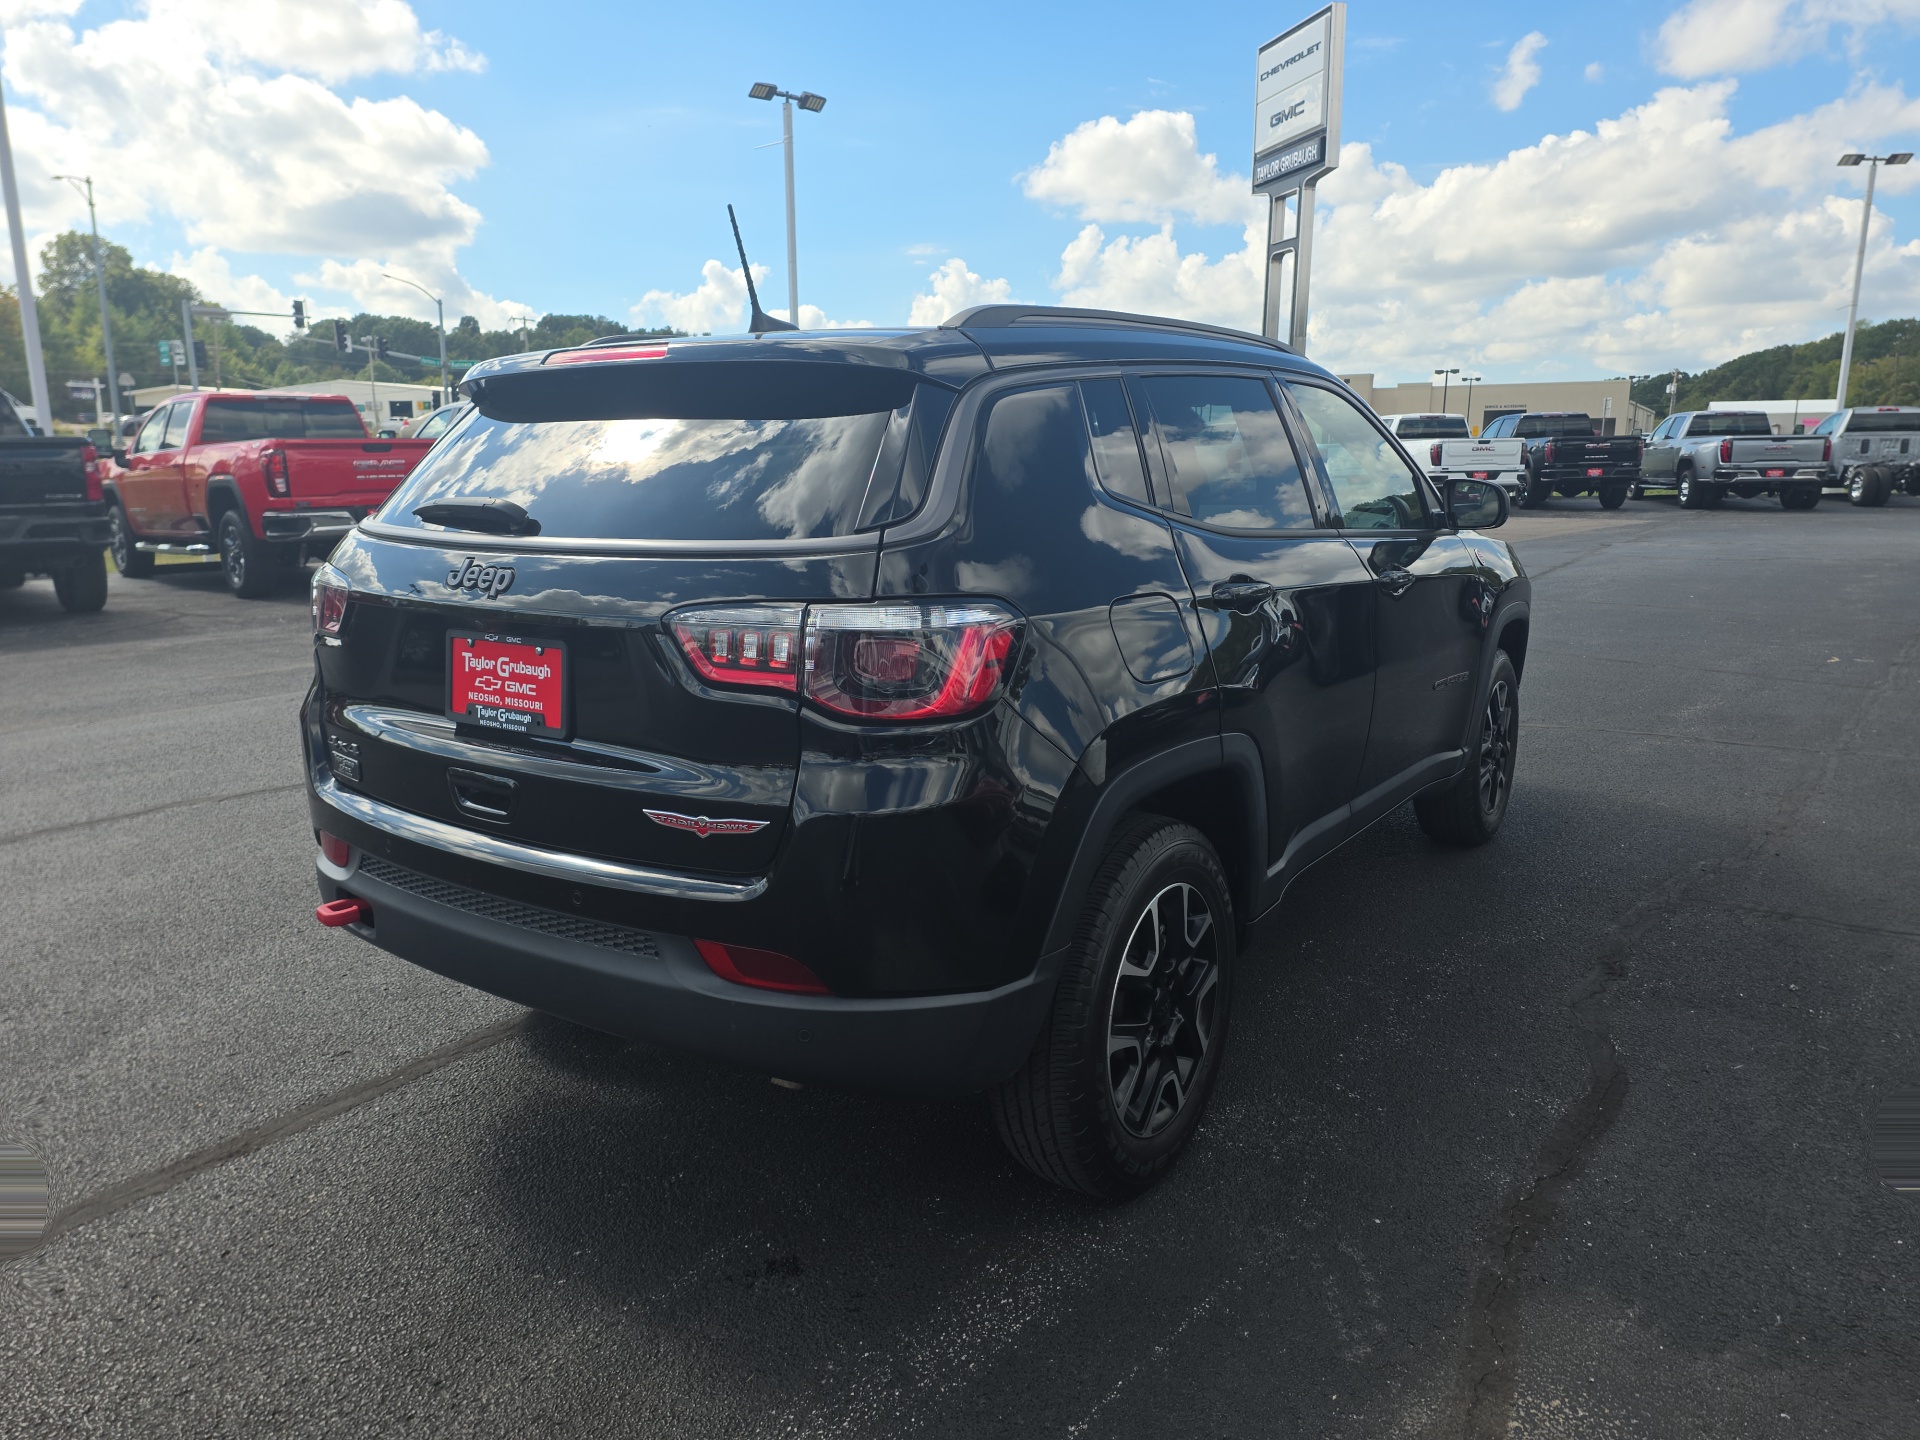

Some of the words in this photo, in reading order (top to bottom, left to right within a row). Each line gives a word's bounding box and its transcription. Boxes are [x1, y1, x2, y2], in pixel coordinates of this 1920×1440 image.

[1260, 41, 1321, 82] CHEVROLET
[1269, 100, 1306, 128] GMC
[1256, 161, 1280, 182] TAYLOR
[1280, 144, 1318, 172] GRUBAUGH
[445, 556, 517, 601] Jeep
[505, 635, 522, 644] GMC
[461, 651, 495, 673] Taylor
[497, 656, 551, 680] Grubaugh
[504, 681, 537, 696] GMC
[468, 691, 503, 706] NEOSHO,
[505, 696, 544, 711] MISSOURI
[475, 704, 498, 718] Taylor
[497, 709, 532, 724] Grubaugh
[479, 719, 502, 728] NEOSHO,
[502, 722, 527, 732] MISSOURI
